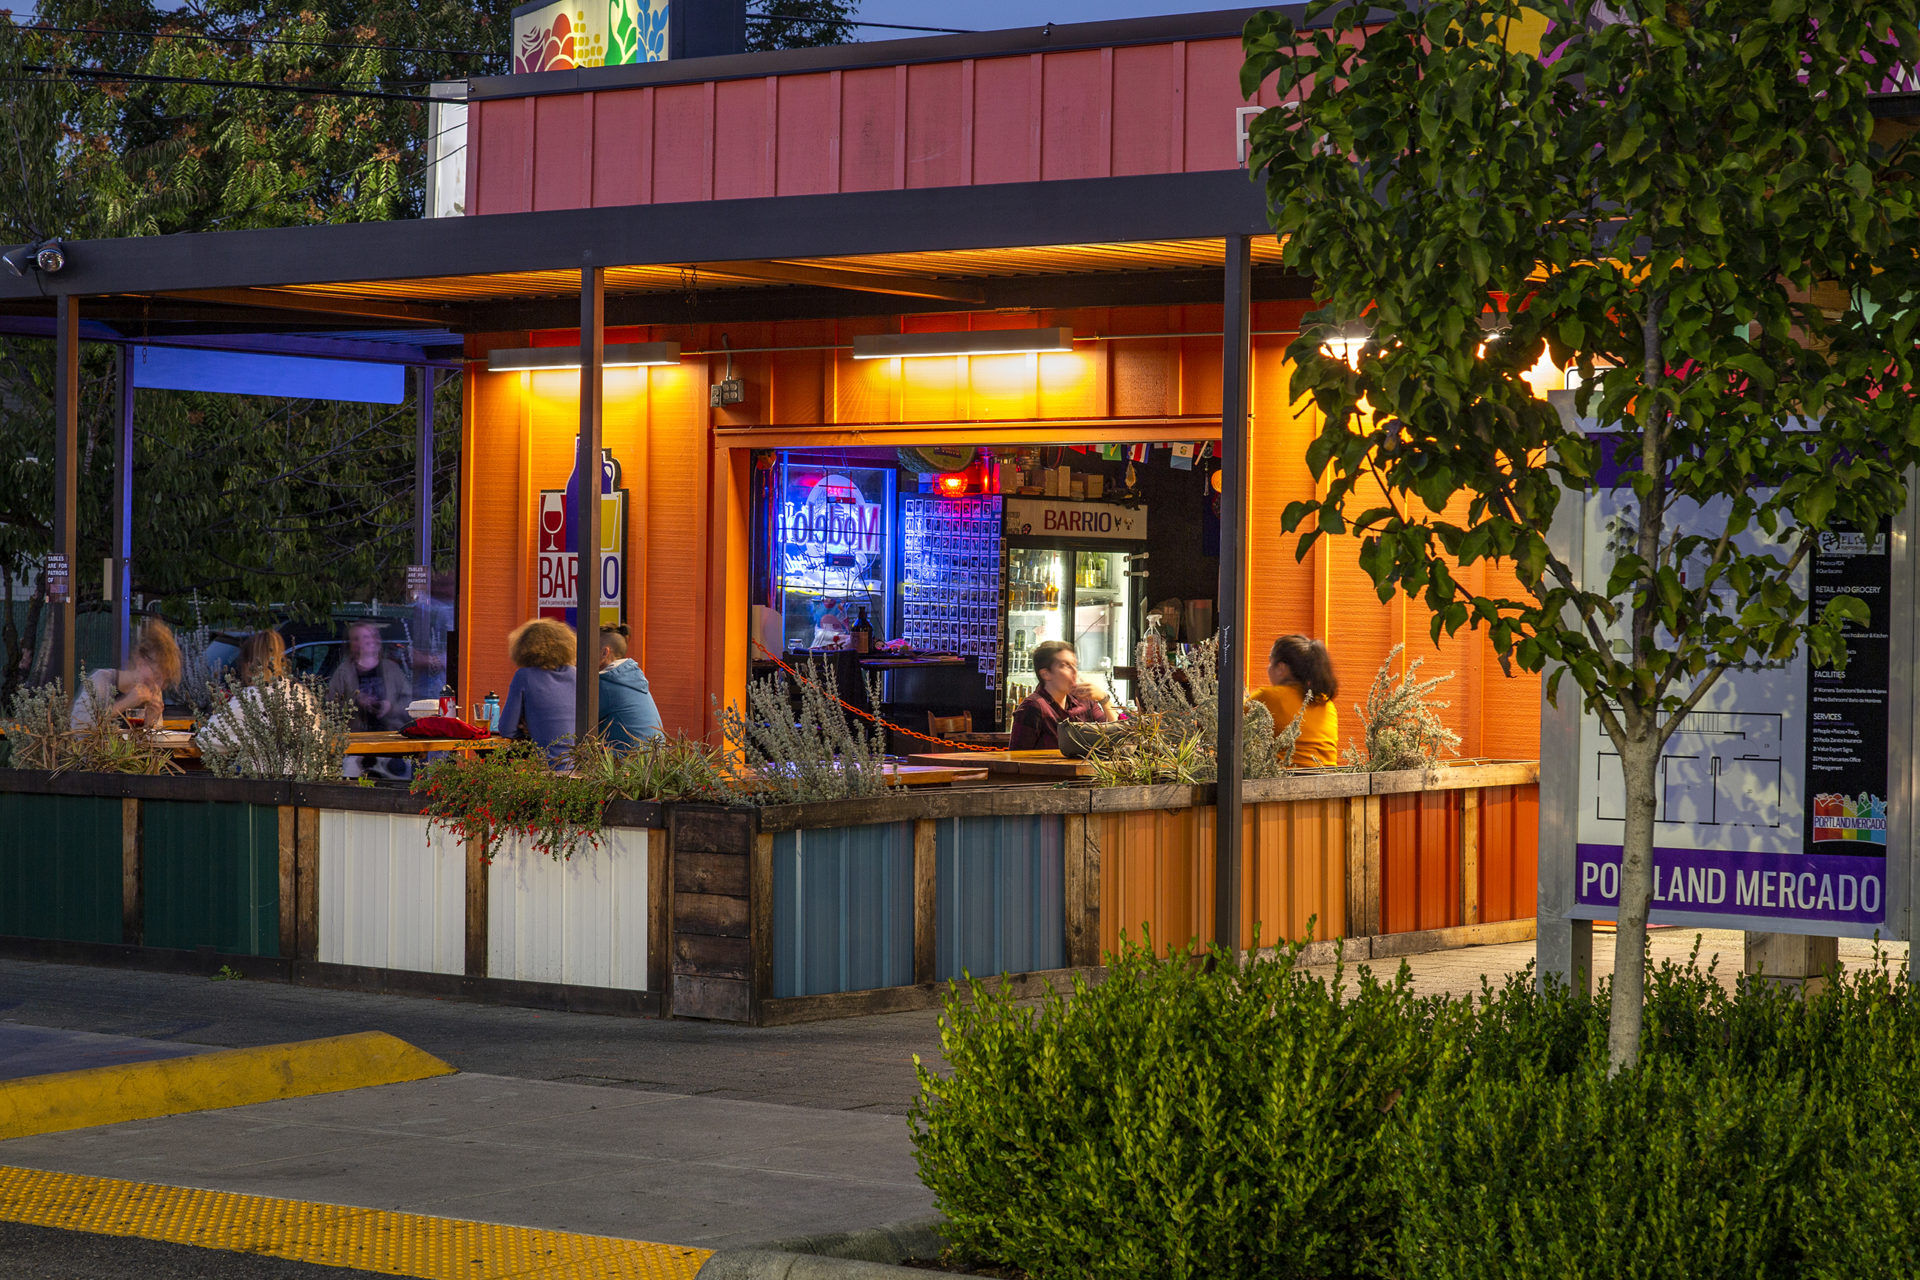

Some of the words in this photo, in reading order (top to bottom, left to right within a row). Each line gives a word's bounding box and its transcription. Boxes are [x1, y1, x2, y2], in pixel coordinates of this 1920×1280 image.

[1044, 509, 1112, 533] BARRIO
[540, 556, 619, 599] BARO
[1815, 816, 1850, 828] PORTLAND
[1851, 818, 1886, 830] MERCADO
[1582, 861, 1727, 904] POLAND
[1736, 869, 1881, 913] MERCADO
